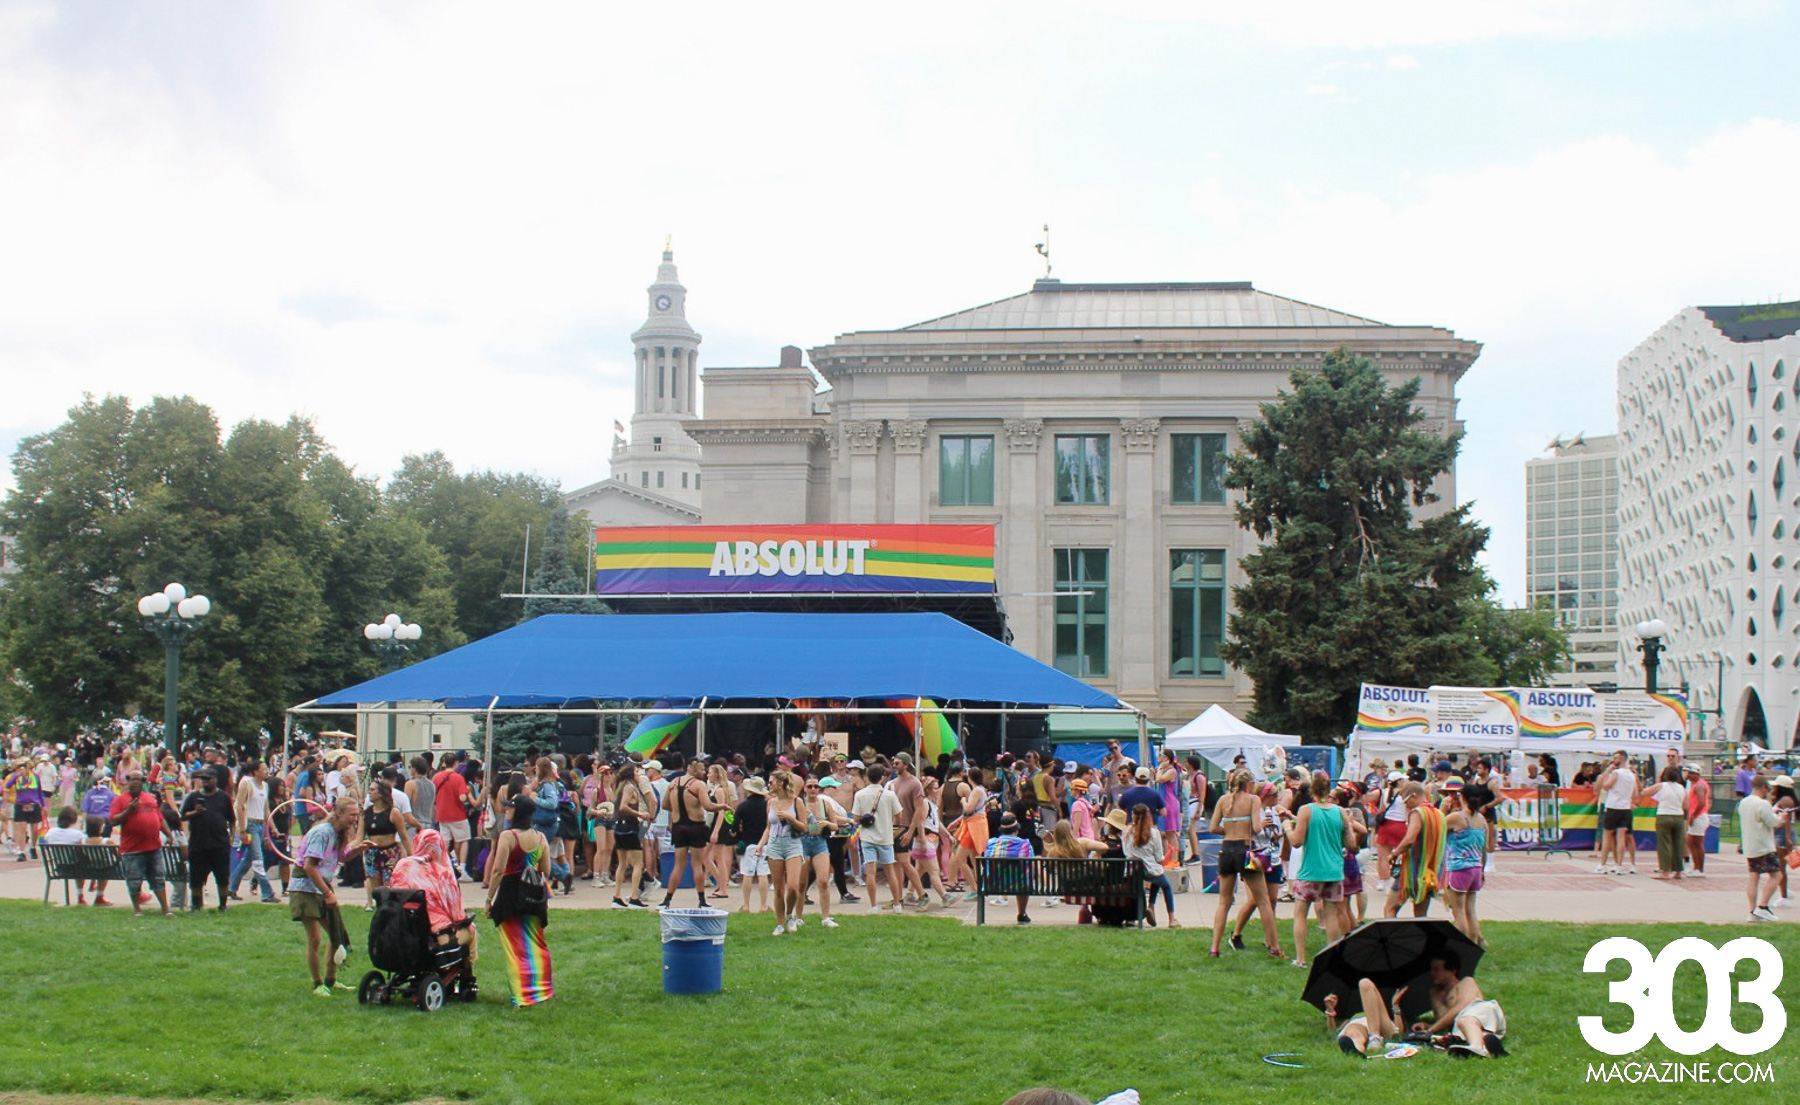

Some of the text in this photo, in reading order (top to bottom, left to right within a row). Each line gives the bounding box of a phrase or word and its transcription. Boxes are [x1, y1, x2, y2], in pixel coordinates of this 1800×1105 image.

[1436, 723, 1514, 735] 10 TICKETS
[1603, 728, 1682, 741] 10 TICKETS
[1495, 798, 1564, 822] OLUT
